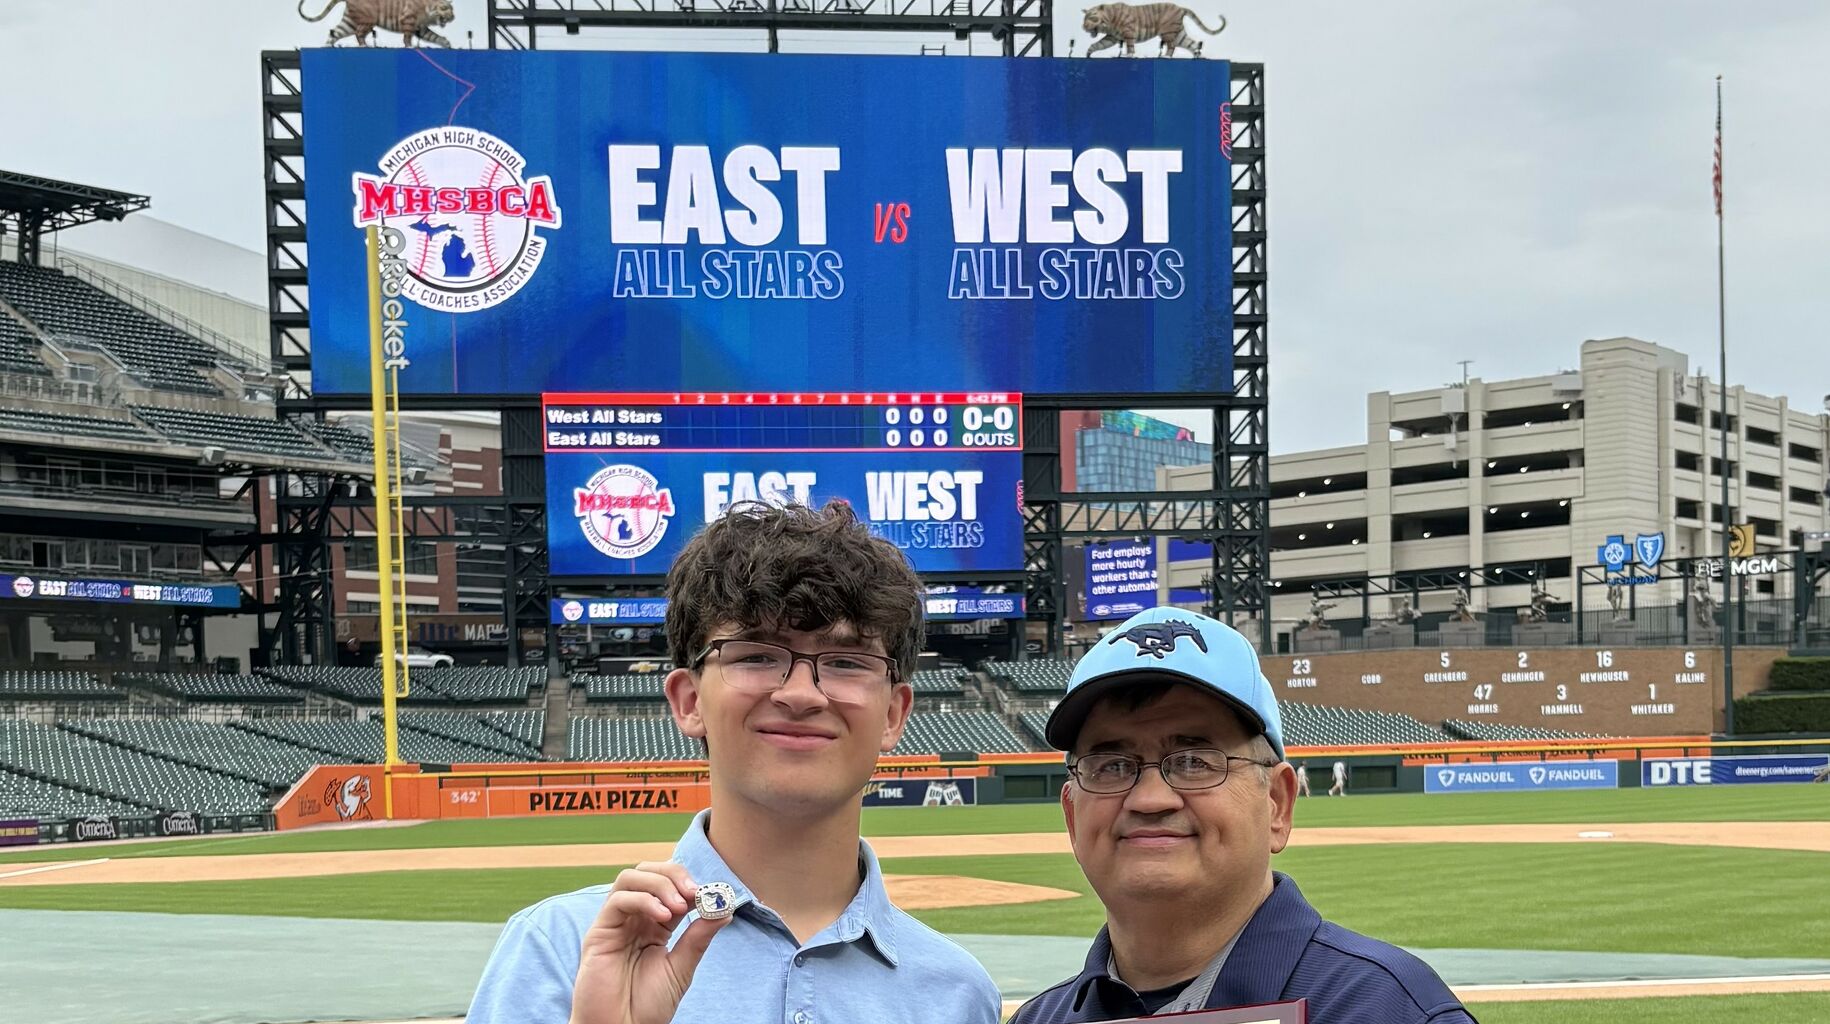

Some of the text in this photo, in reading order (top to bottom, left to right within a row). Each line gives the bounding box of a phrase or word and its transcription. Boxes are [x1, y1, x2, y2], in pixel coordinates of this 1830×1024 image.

[384, 131, 522, 174] MICHIGAN HIGH SCHOOL
[358, 178, 557, 223] MHSBCA
[608, 144, 840, 245] EAST
[946, 147, 1183, 245] WEST
[874, 203, 911, 243] VS
[420, 240, 542, 309] COACHES ASSOCIATION
[613, 249, 844, 300] ALL STARS
[948, 248, 1185, 300] ALL STARS
[381, 258, 411, 370] Rocket
[547, 407, 948, 424] West All Stars 0 0 0
[548, 429, 948, 446] East All Stars 0 0 0
[703, 472, 816, 523] EAST
[865, 471, 984, 521] WEST
[911, 521, 985, 549] STARS
[1092, 546, 1152, 559] Ford employs
[1092, 558, 1146, 571] more hourly
[1092, 571, 1127, 583] workers
[1128, 570, 1149, 580] than
[39, 581, 67, 595] EAST
[134, 585, 161, 599] WEST
[1092, 584, 1117, 595] other
[588, 603, 619, 617] EAST
[926, 599, 957, 613] WEST
[1292, 659, 1311, 675] 23
[1440, 652, 1450, 668] 5
[1518, 651, 1528, 668] 2
[1595, 651, 1613, 668] 16
[1684, 651, 1695, 668] 6
[1424, 672, 1467, 683] GREENBERG
[1501, 671, 1545, 683] GEHRINGER
[1580, 671, 1629, 683] NEWHOUSER
[1675, 672, 1706, 683] KALINE
[1473, 684, 1493, 700] 47
[1556, 684, 1567, 700] 3
[1648, 683, 1656, 700] 1
[1467, 704, 1498, 714] MORRIS
[1541, 704, 1583, 715] TRAMMELL
[1631, 703, 1674, 715] WHITAKER
[1458, 771, 1515, 784] FANDUEL
[1549, 768, 1605, 781] FANDUEL
[1651, 761, 1711, 784] DTE
[530, 789, 679, 811] PIZZA! PIZZA!
[878, 788, 904, 799] TIME
